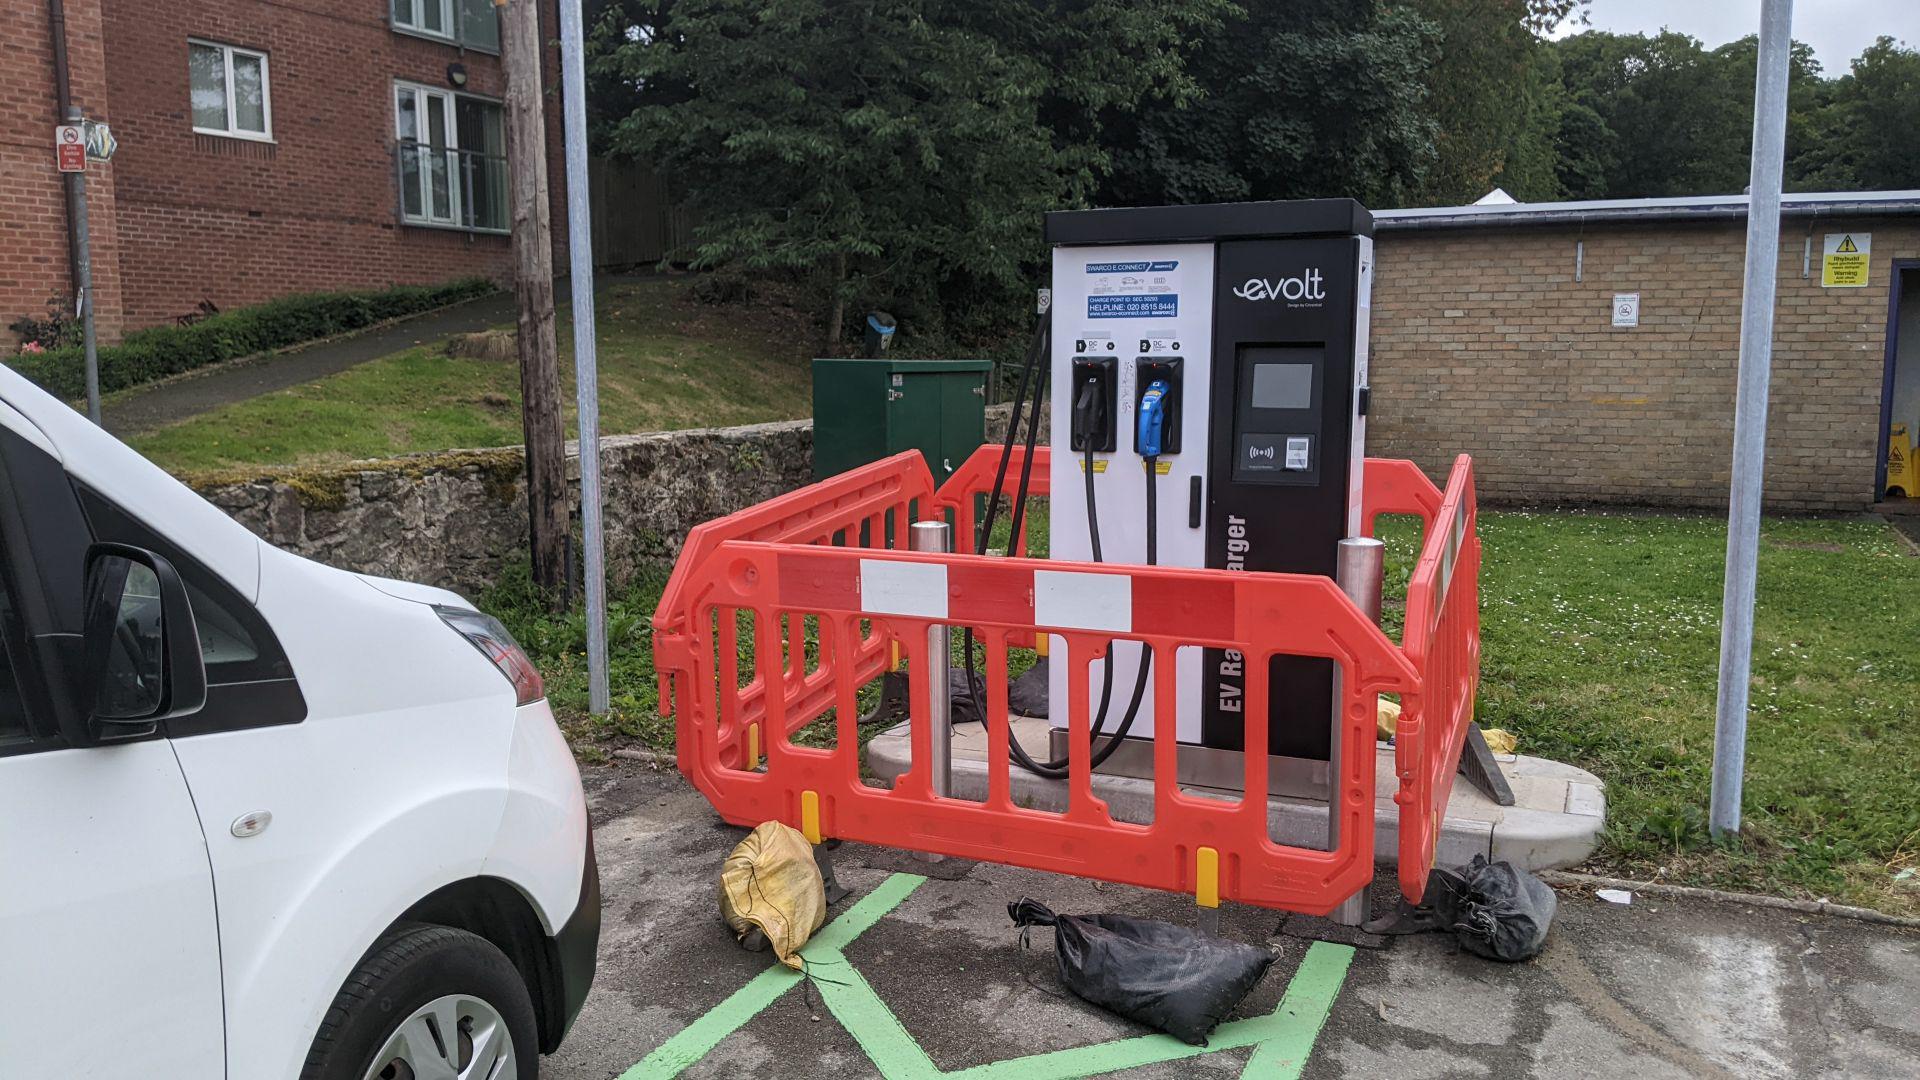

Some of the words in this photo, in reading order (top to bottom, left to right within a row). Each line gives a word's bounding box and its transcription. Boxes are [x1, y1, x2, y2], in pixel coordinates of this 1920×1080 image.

[1233, 268, 1326, 301] evolt
[1089, 304, 1126, 312] HELPLINE:
[1127, 303, 1140, 311] 020
[1226, 515, 1250, 571] arger
[1220, 683, 1242, 712] EV
